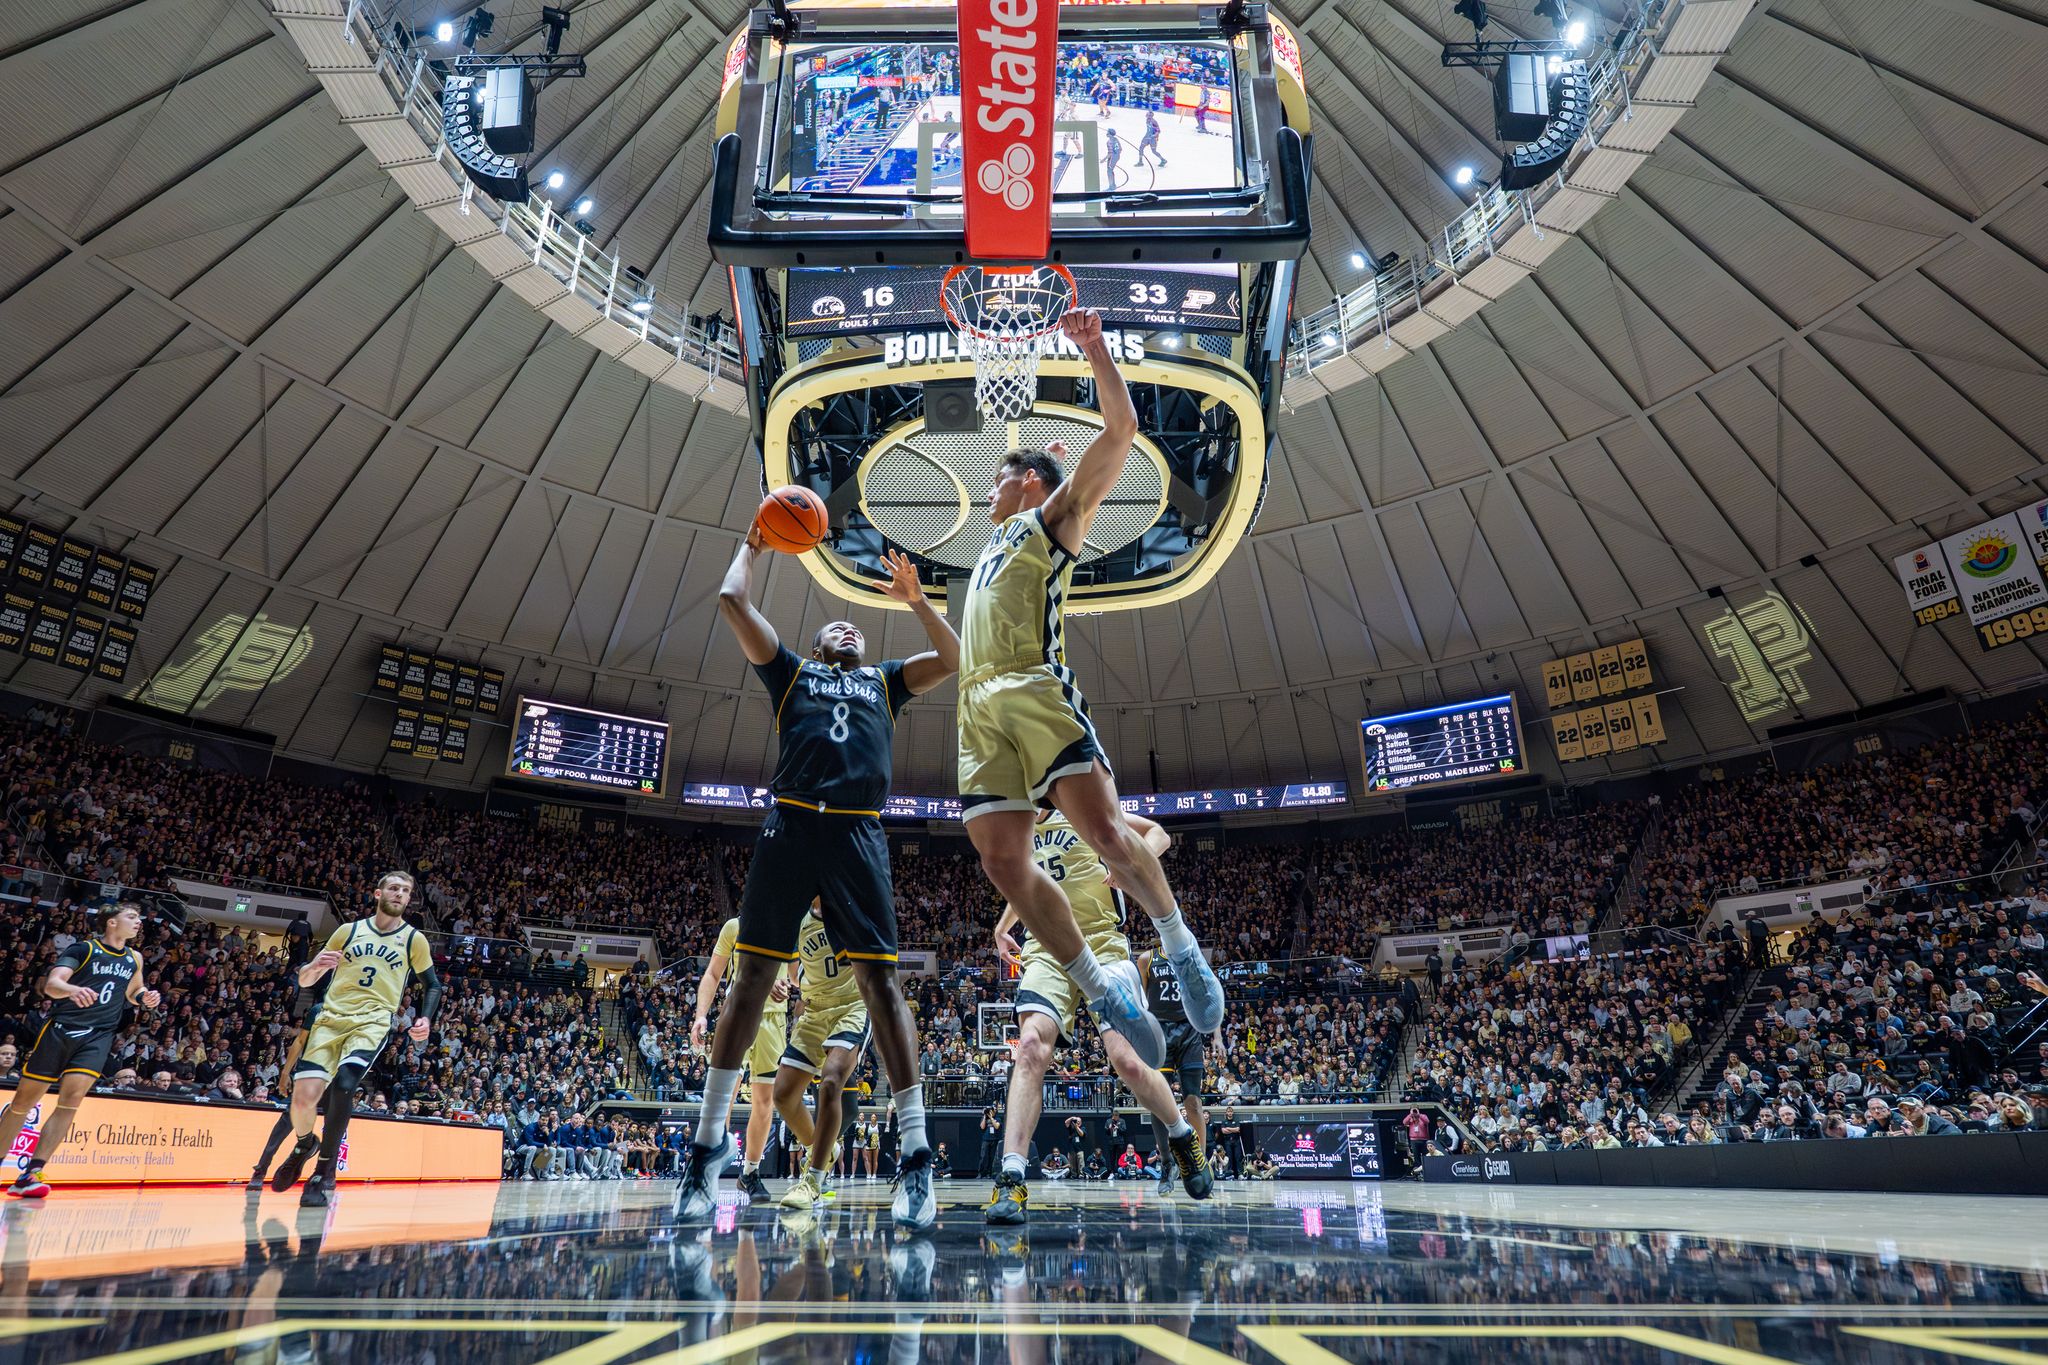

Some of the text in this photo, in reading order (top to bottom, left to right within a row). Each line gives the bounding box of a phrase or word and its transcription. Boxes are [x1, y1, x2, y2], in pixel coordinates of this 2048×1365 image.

[977, 0, 1037, 137] State
[862, 286, 895, 308] 16
[1129, 283, 1168, 304] 33
[838, 318, 879, 329] FOULS 6
[1144, 314, 1186, 324] FOULS 4
[28, 529, 59, 545] PURDUE
[63, 541, 92, 558] PURDUE
[18, 566, 43, 582] 1938
[128, 565, 155, 580] PURDUE
[976, 552, 1006, 591] 17
[53, 578, 78, 594] 1940
[1908, 570, 1946, 591] FINAL
[1913, 581, 1948, 600] FOUR
[1972, 576, 2032, 604] NATIONAL
[4, 592, 35, 609] PURDUE
[1971, 584, 2041, 615] CHAMPIONS
[41, 604, 69, 620] PURDUE
[120, 600, 143, 615] 1979
[1916, 598, 1961, 626] 1994
[1980, 606, 2048, 648] 1999
[65, 653, 90, 668] 1994
[1624, 654, 1647, 672] 32
[99, 662, 122, 677] 1995
[1572, 667, 1594, 684] 40
[1598, 661, 1621, 679] 22
[1549, 674, 1566, 689] 41
[808, 676, 878, 703] Kent State
[454, 696, 473, 706] 2017
[829, 701, 850, 743] 8
[1438, 706, 1511, 725] PTS REB AST BLK FOUL
[1643, 711, 1653, 726] 1
[542, 719, 555, 728] Cox
[598, 722, 609, 731] PTS
[626, 726, 636, 735] AST
[640, 728, 650, 737] BLK
[653, 730, 665, 740] FOUL
[1583, 722, 1606, 739] 32
[1610, 716, 1632, 734] 50
[529, 734, 564, 746] 14 Benter
[541, 727, 561, 738] Smith
[1557, 728, 1579, 744] 22
[390, 739, 412, 750] 2023
[416, 744, 438, 754] 2023
[527, 742, 560, 754] 17 Mayer
[1386, 739, 1410, 749] Safford
[1386, 747, 1412, 756] Briscoe
[1854, 736, 1883, 754] 108
[168, 743, 194, 761] 103
[524, 751, 555, 761] 45 Cluff
[1376, 754, 1417, 767] 23 Gillespie
[1389, 762, 1426, 773] Williamson
[538, 766, 564, 776] GREAT
[564, 770, 588, 780] FOOD.
[590, 774, 613, 784] MADE
[1394, 775, 1419, 785] GREAT
[1419, 771, 1443, 782] FOOD.
[1445, 767, 1469, 777] MADE
[700, 786, 730, 798] 84.80
[1203, 792, 1213, 800] 10
[1233, 793, 1247, 806] TO
[1302, 786, 1332, 798] 84.80
[684, 797, 707, 805] MACKEY
[707, 798, 725, 806] NOISE
[894, 798, 917, 806] 41.7%
[1120, 799, 1139, 812] REB
[1176, 796, 1196, 809] AST
[1327, 796, 1346, 804] METER
[539, 803, 583, 822] PAINT
[890, 807, 916, 816] 22.2%
[927, 802, 940, 814] FT
[594, 820, 615, 833] 104
[1411, 821, 1449, 831] WABASH
[901, 844, 920, 856] 105
[1196, 840, 1216, 852] 106
[344, 942, 403, 970] PURDUE
[92, 961, 113, 975] Kent
[823, 956, 839, 978] 0
[358, 965, 377, 987] 3
[99, 980, 116, 1005] 6
[1160, 980, 1181, 1001] 23
[96, 1123, 168, 1148] Children's
[171, 1127, 213, 1149] Health
[1364, 1132, 1375, 1141] 33
[51, 1149, 175, 1170] ndiana University Health
[1286, 1153, 1319, 1163] Children's
[1319, 1153, 1342, 1163] Health
[1295, 1161, 1317, 1169] University
[1367, 1160, 1379, 1169] 16
[1455, 1165, 1480, 1174] InnerVision
[1492, 1160, 1511, 1176] GEMCO
